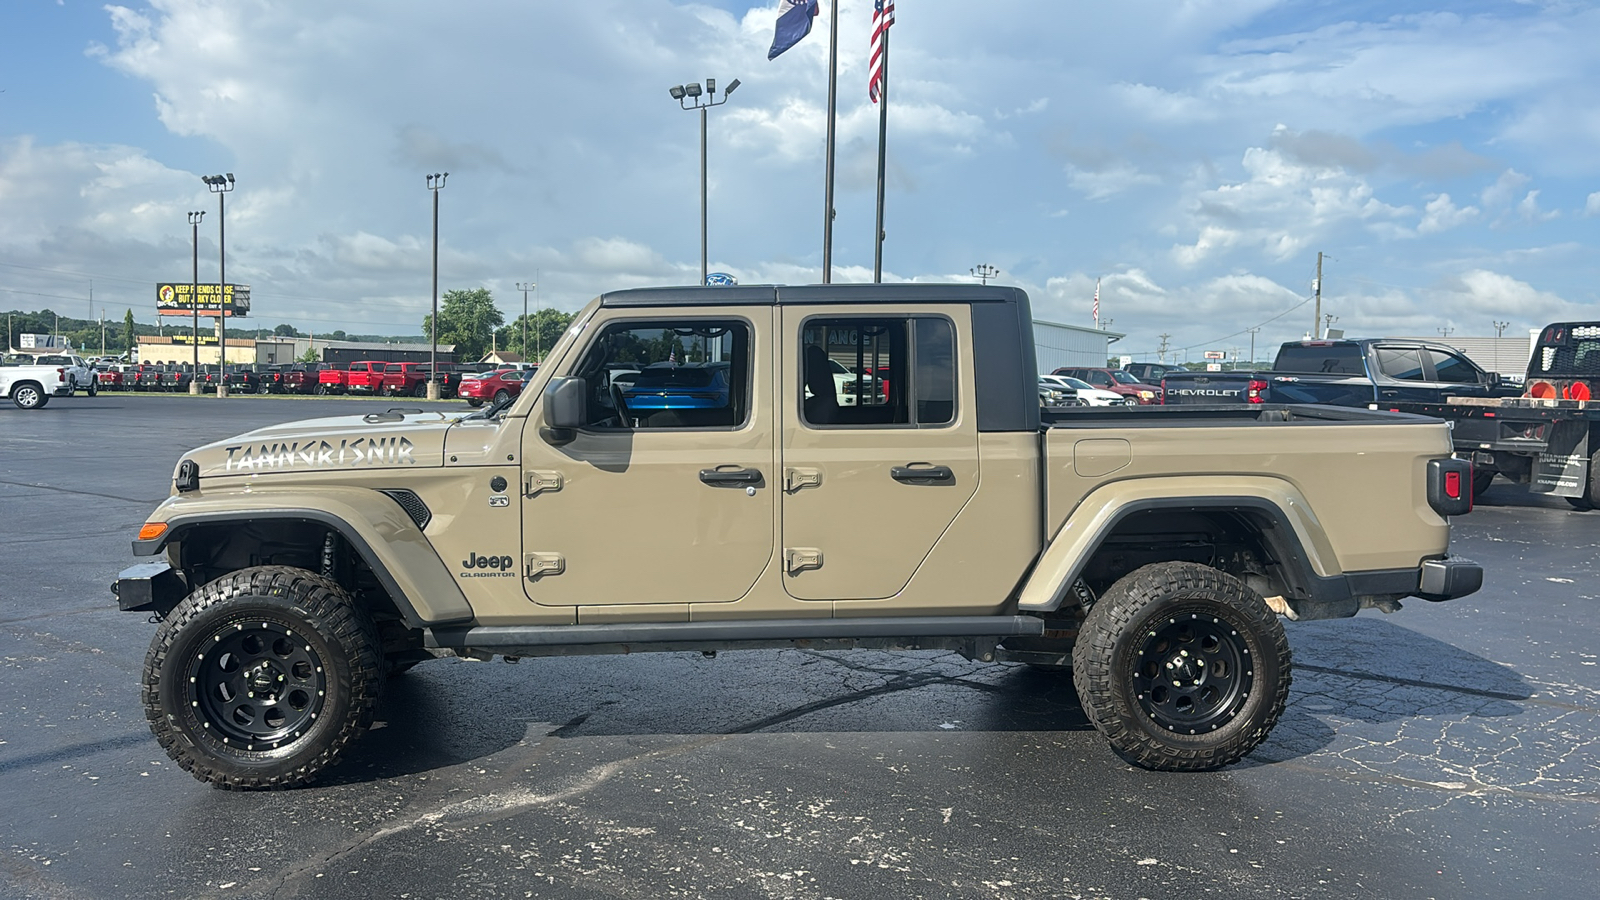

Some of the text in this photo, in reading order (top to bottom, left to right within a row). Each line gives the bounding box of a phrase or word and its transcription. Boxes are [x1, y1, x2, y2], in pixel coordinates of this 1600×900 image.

[175, 285, 189, 294] KEEP
[190, 285, 214, 294] FIENDS
[178, 294, 232, 304] BUT JRKY CLOER
[1167, 388, 1241, 397] CHEVROLET
[224, 436, 416, 472] TANNGRISNIR
[462, 552, 513, 571] Jeep
